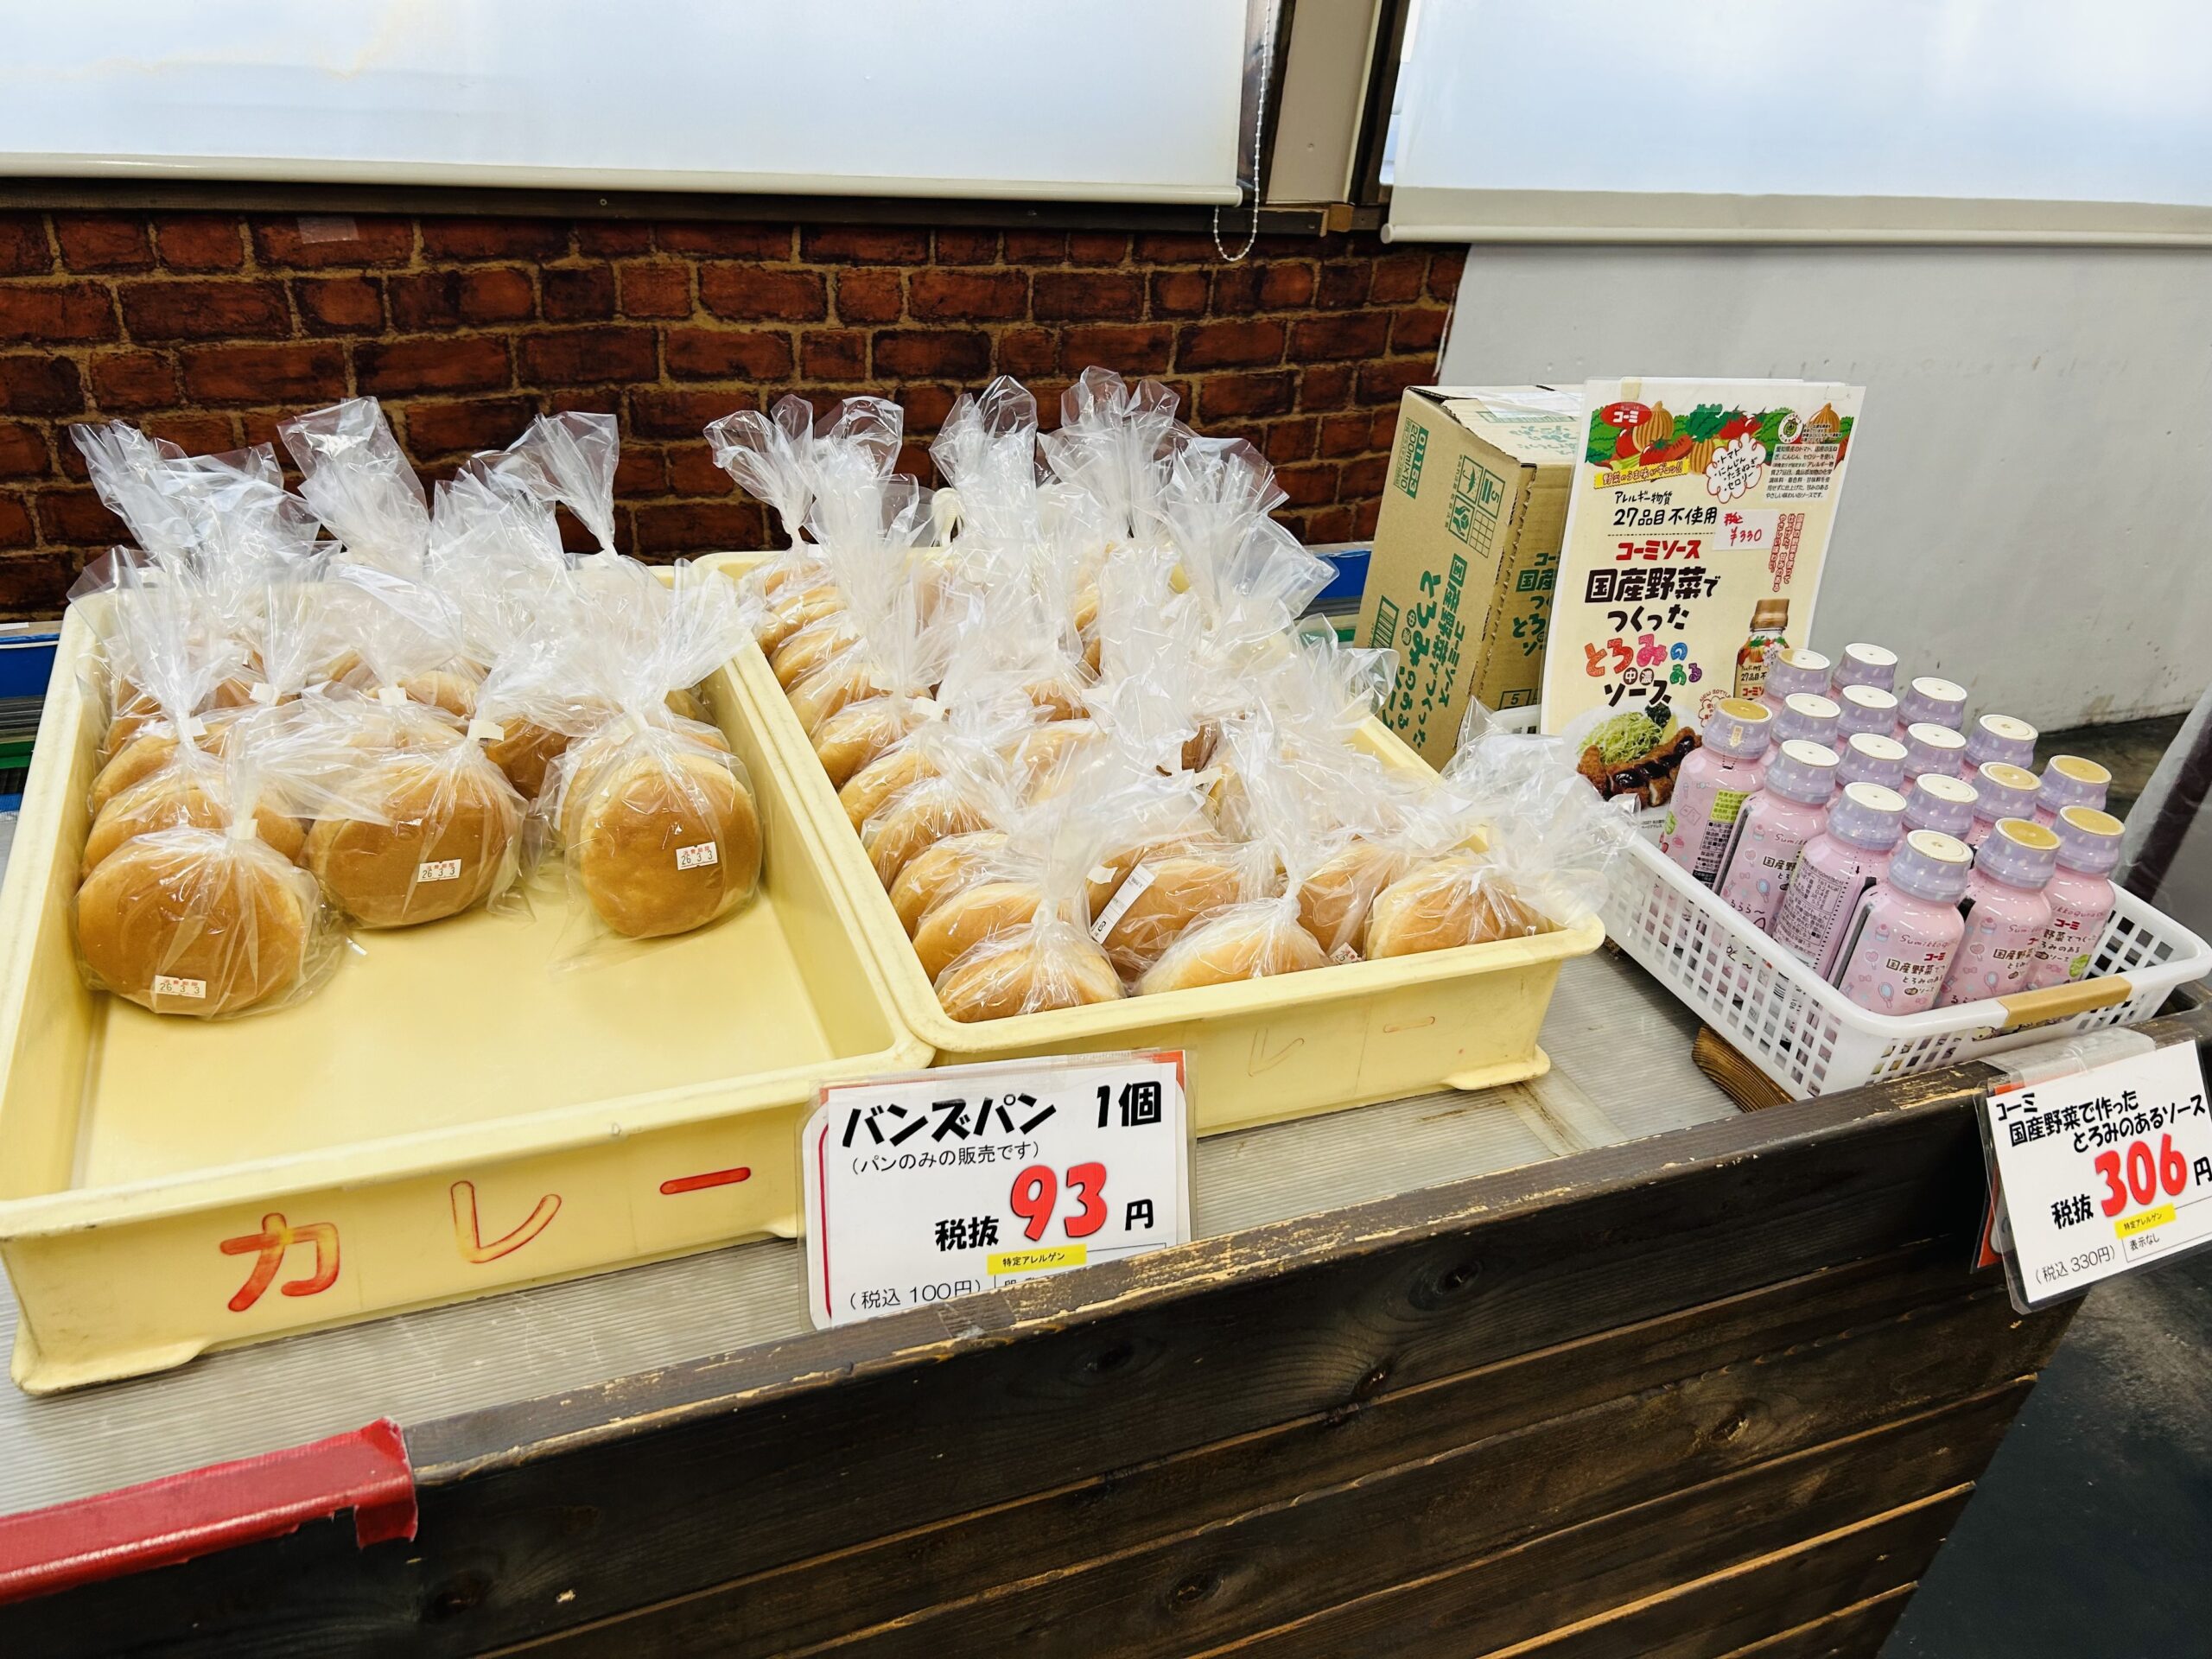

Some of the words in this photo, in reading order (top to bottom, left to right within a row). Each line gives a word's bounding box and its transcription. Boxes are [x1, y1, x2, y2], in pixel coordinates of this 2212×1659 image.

[1612, 410, 1639, 423] コーミ
[1408, 433, 1427, 493] 01153
[1491, 490, 1500, 503] 5
[1614, 491, 1673, 505] アレルギー物質
[1730, 526, 1763, 547] ¥330
[1535, 552, 1560, 566] コー
[1616, 540, 1701, 561] コーミソース
[1585, 566, 1721, 603] 国産野菜で
[1607, 604, 1689, 632] つくった
[1397, 570, 1441, 729] とろみのある
[1413, 553, 1467, 748] 国産野菜でつくった
[1439, 620, 1465, 708] コーミソース
[1623, 667, 1655, 685] 中濃
[1510, 693, 1520, 705] 5
[1604, 680, 1672, 708] ソース
[682, 855, 690, 865] 26
[423, 869, 432, 878] 26
[2054, 918, 2081, 930] コーミ
[1924, 952, 1946, 961] コーミ
[160, 982, 172, 991] 26
[842, 1092, 1057, 1147] バンズパン
[1096, 1080, 1161, 1128] 1個
[2009, 1090, 2139, 1147] 国産野菜で作った
[2073, 1094, 2206, 1154] とろみのあるソース
[852, 1141, 1039, 1175] （パンのみの販売です）
[2050, 1193, 2094, 1230] 税抜
[2094, 1133, 2187, 1217] 306
[2193, 1156, 2212, 1185] 円
[936, 1216, 999, 1251] 税抜
[1011, 1161, 1108, 1242] 93
[1125, 1198, 1154, 1231] 円
[2123, 1211, 2163, 1231] 特定アレルゲン
[2129, 1232, 2160, 1251] 表示なし
[1002, 1252, 1065, 1268] 特定アレルゲン
